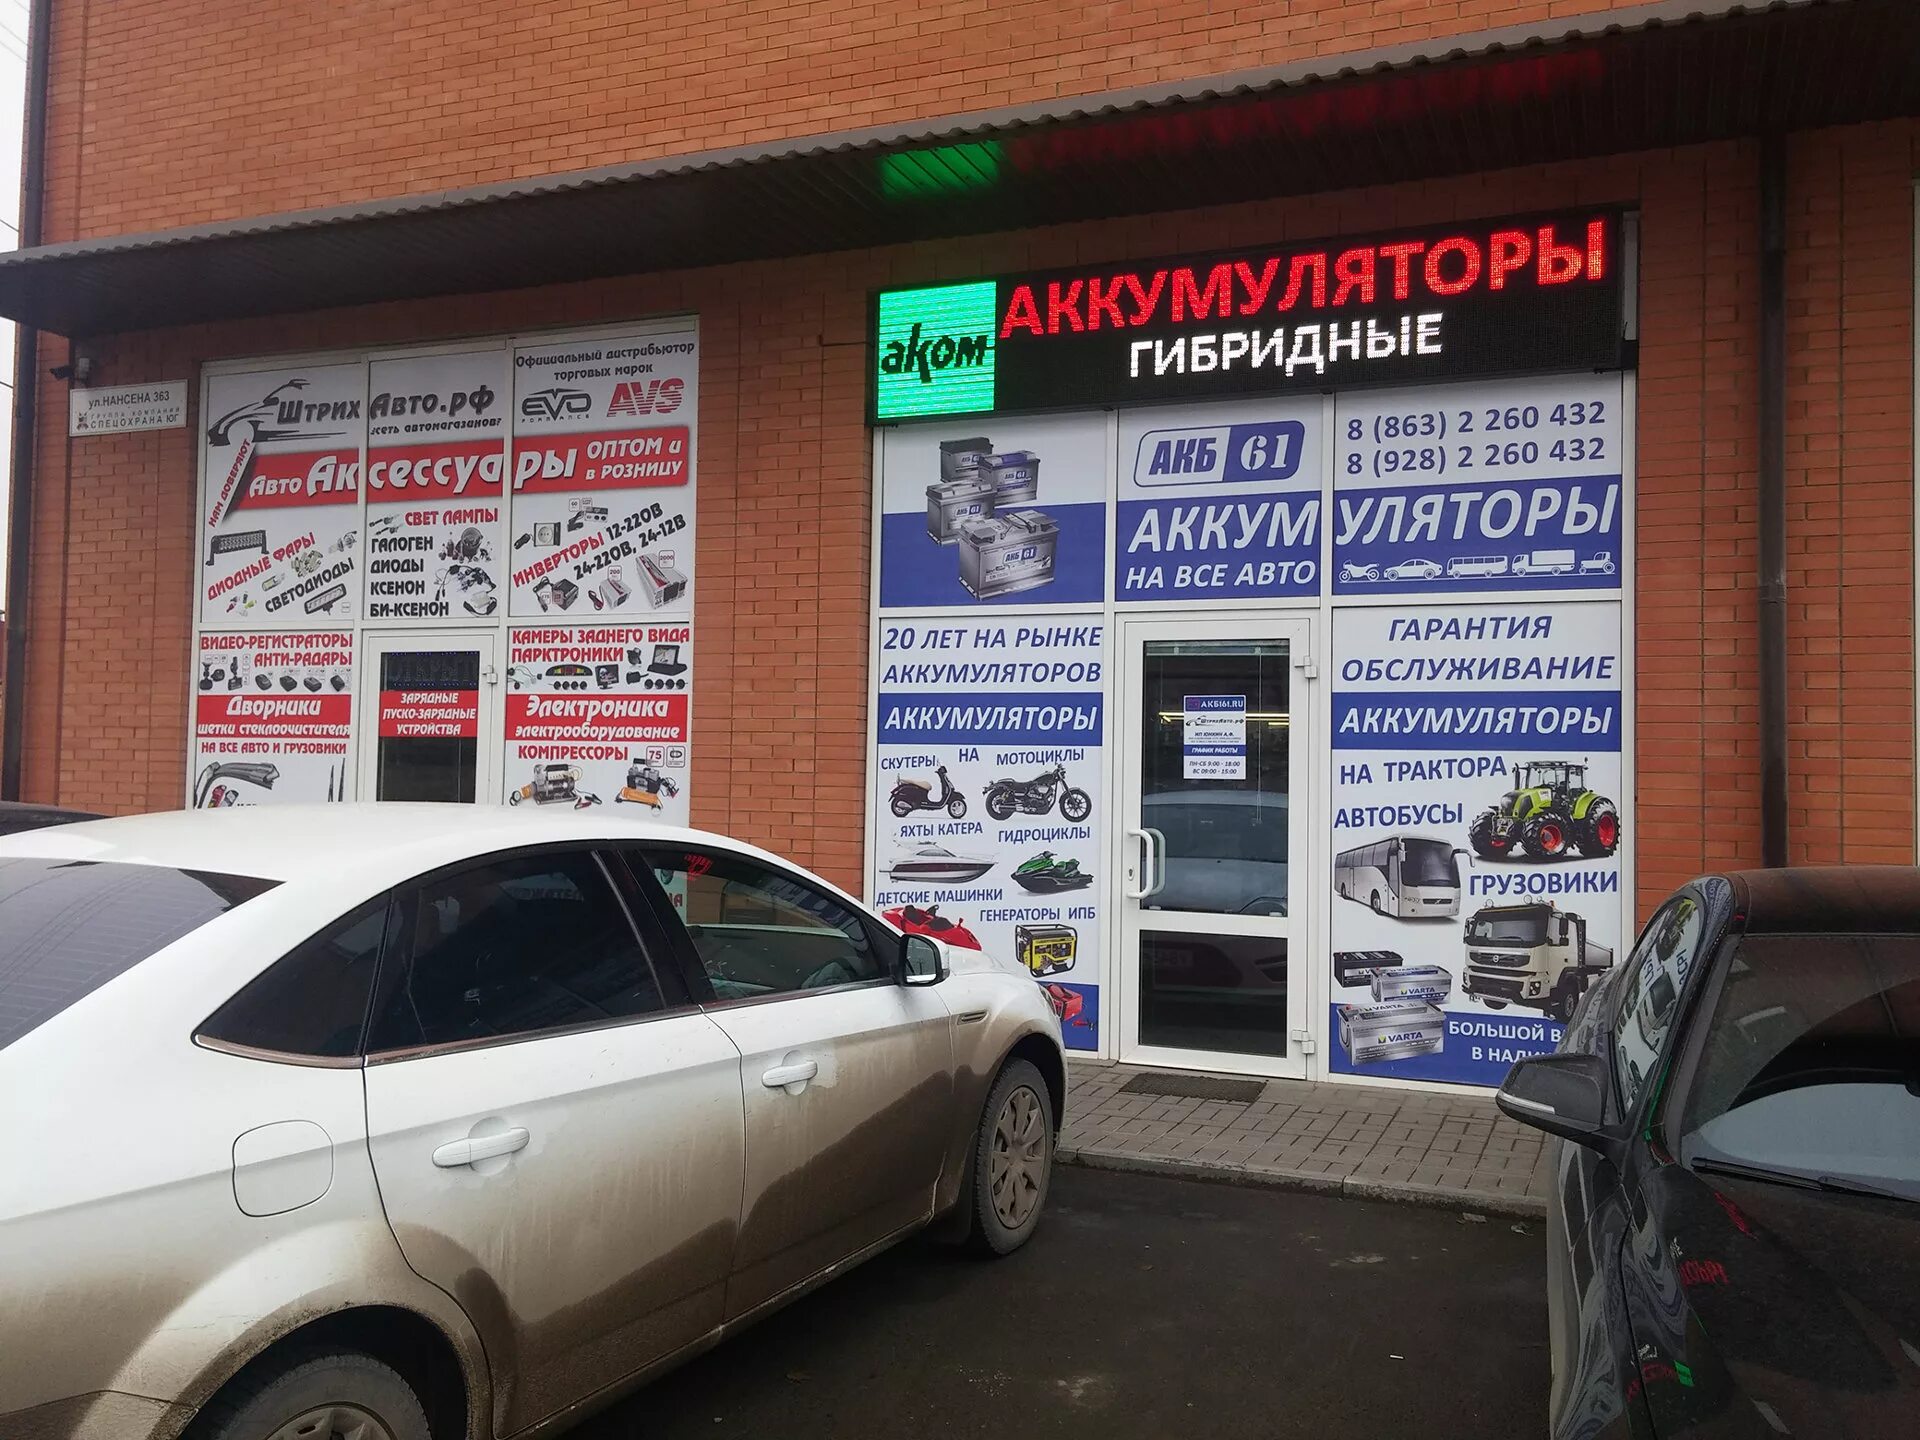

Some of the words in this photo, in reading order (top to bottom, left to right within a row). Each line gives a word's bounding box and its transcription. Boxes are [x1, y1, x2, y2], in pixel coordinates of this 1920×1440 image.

[1000, 221, 1604, 339] АККУМУЛЯТОРЫ
[516, 350, 602, 368] Официальный
[605, 343, 695, 360] дистрибьютор
[1130, 313, 1443, 378] ГИБРИДНЫЕ
[554, 366, 611, 382] торговых
[615, 363, 653, 377] марок
[153, 391, 170, 402] 363
[521, 388, 592, 422] EVO
[606, 377, 685, 418] AVS
[91, 416, 163, 429] СПЕЦОХРАНА
[166, 414, 179, 423] ЮГ
[1347, 418, 1363, 441] 8
[1373, 410, 1447, 444] (863)
[1458, 411, 1474, 433] 2
[1485, 405, 1539, 431] 260
[1549, 401, 1606, 427] 432
[587, 437, 663, 461] ОПТОМ
[1149, 437, 1217, 476] АКБ
[1240, 434, 1290, 471] 61
[1346, 452, 1363, 475] 8
[1373, 445, 1446, 478] (928)
[1457, 445, 1473, 468] 2
[1484, 441, 1539, 466] 260
[1549, 437, 1606, 462] 432
[600, 460, 683, 480] РОЗНИЦУ
[208, 501, 224, 528] НАМ
[220, 438, 251, 501] ДОВЕРЯЮТ
[405, 510, 438, 527] СВЕТ
[443, 508, 498, 525] ЛАМПЫ
[638, 513, 687, 549] 24-12В
[371, 536, 434, 553] ГАЛОГЕН
[513, 531, 605, 588] ИНВЕРТОРЫ
[605, 502, 664, 541] 12-220В
[1023, 549, 1034, 561] 61
[207, 555, 272, 601] ДИОДНЫЕ
[272, 531, 316, 562] ФАРЫ
[370, 558, 424, 575] ДИОДЫ
[1125, 566, 1164, 589] НА
[1174, 563, 1229, 588] ВСЕ
[1234, 560, 1316, 586] АВТО
[264, 557, 355, 613] СВЕТОДИОДЫ
[370, 580, 425, 596] КСЕНОН
[369, 601, 449, 618] БИ-КСЕНОН
[512, 629, 573, 644] КАМЕРЫ
[577, 628, 643, 643] ЗАДНЕГО
[647, 628, 690, 643] ВИДА
[883, 627, 916, 650] 20
[921, 629, 968, 649] ЛЕТ
[973, 628, 1007, 648] НА
[1015, 626, 1104, 647] РЫНКЕ
[1388, 615, 1553, 642] ГАРАНТИЯ
[200, 633, 353, 651] ВИДЕО-РЕГИСТРАТОРЫ
[253, 651, 353, 667] АНТИ-РАДАРЫ
[511, 647, 624, 663] ПАРКТРОНИКИ
[882, 662, 1102, 684] АККУМУЛЯТОРОВ
[1341, 655, 1615, 682] ОБСЛУЖИВАНИЕ
[226, 695, 321, 720] Дворники
[400, 692, 459, 705] ЗАРЯДНЫЕ
[525, 695, 669, 721] Электроника
[383, 708, 477, 720] ПУСКО-ЗАРЯДНЫЕ
[884, 706, 1098, 731] АККУМУЛЯТОРЫ
[1339, 706, 1613, 735] АККУМУЛЯТОРЫ
[239, 722, 350, 736] стеклоочистителя
[396, 722, 462, 736] УСТРОЙСТВА
[515, 721, 680, 741] электрооборудование
[201, 742, 216, 754] НА
[219, 742, 238, 753] ВСЕ
[241, 742, 270, 754] АВТО
[273, 742, 280, 753] И
[283, 742, 347, 755] ГРУЗОВИКИ
[518, 745, 629, 761] КОМПРЕССОРЫ
[649, 750, 662, 760] 75
[881, 755, 936, 770] СКУТЕРЫ
[958, 748, 980, 763] НА
[996, 748, 1085, 766] МОТОЦИКЛЫ
[1340, 764, 1374, 785] НА
[1383, 756, 1508, 783] ТРАКТОРА
[1334, 802, 1464, 829] АВТОБУСЫ
[900, 823, 934, 838] ЯХТЫ
[938, 821, 984, 836] КАТЕРА
[998, 826, 1091, 844] ГИДРОЦИКЛЫ
[1469, 871, 1618, 897] ГРУЗОВИКИ
[876, 890, 930, 907] ДЕТСКИЕ
[933, 888, 1003, 903] МАШИНКИ
[979, 908, 1060, 922] ГЕНЕРАТОРЫ
[1068, 906, 1096, 920] ИПБ
[1388, 1031, 1423, 1043] VARTA
[1448, 1020, 1545, 1042] БОЛЬШОЙ
[1471, 1046, 1483, 1060] В
